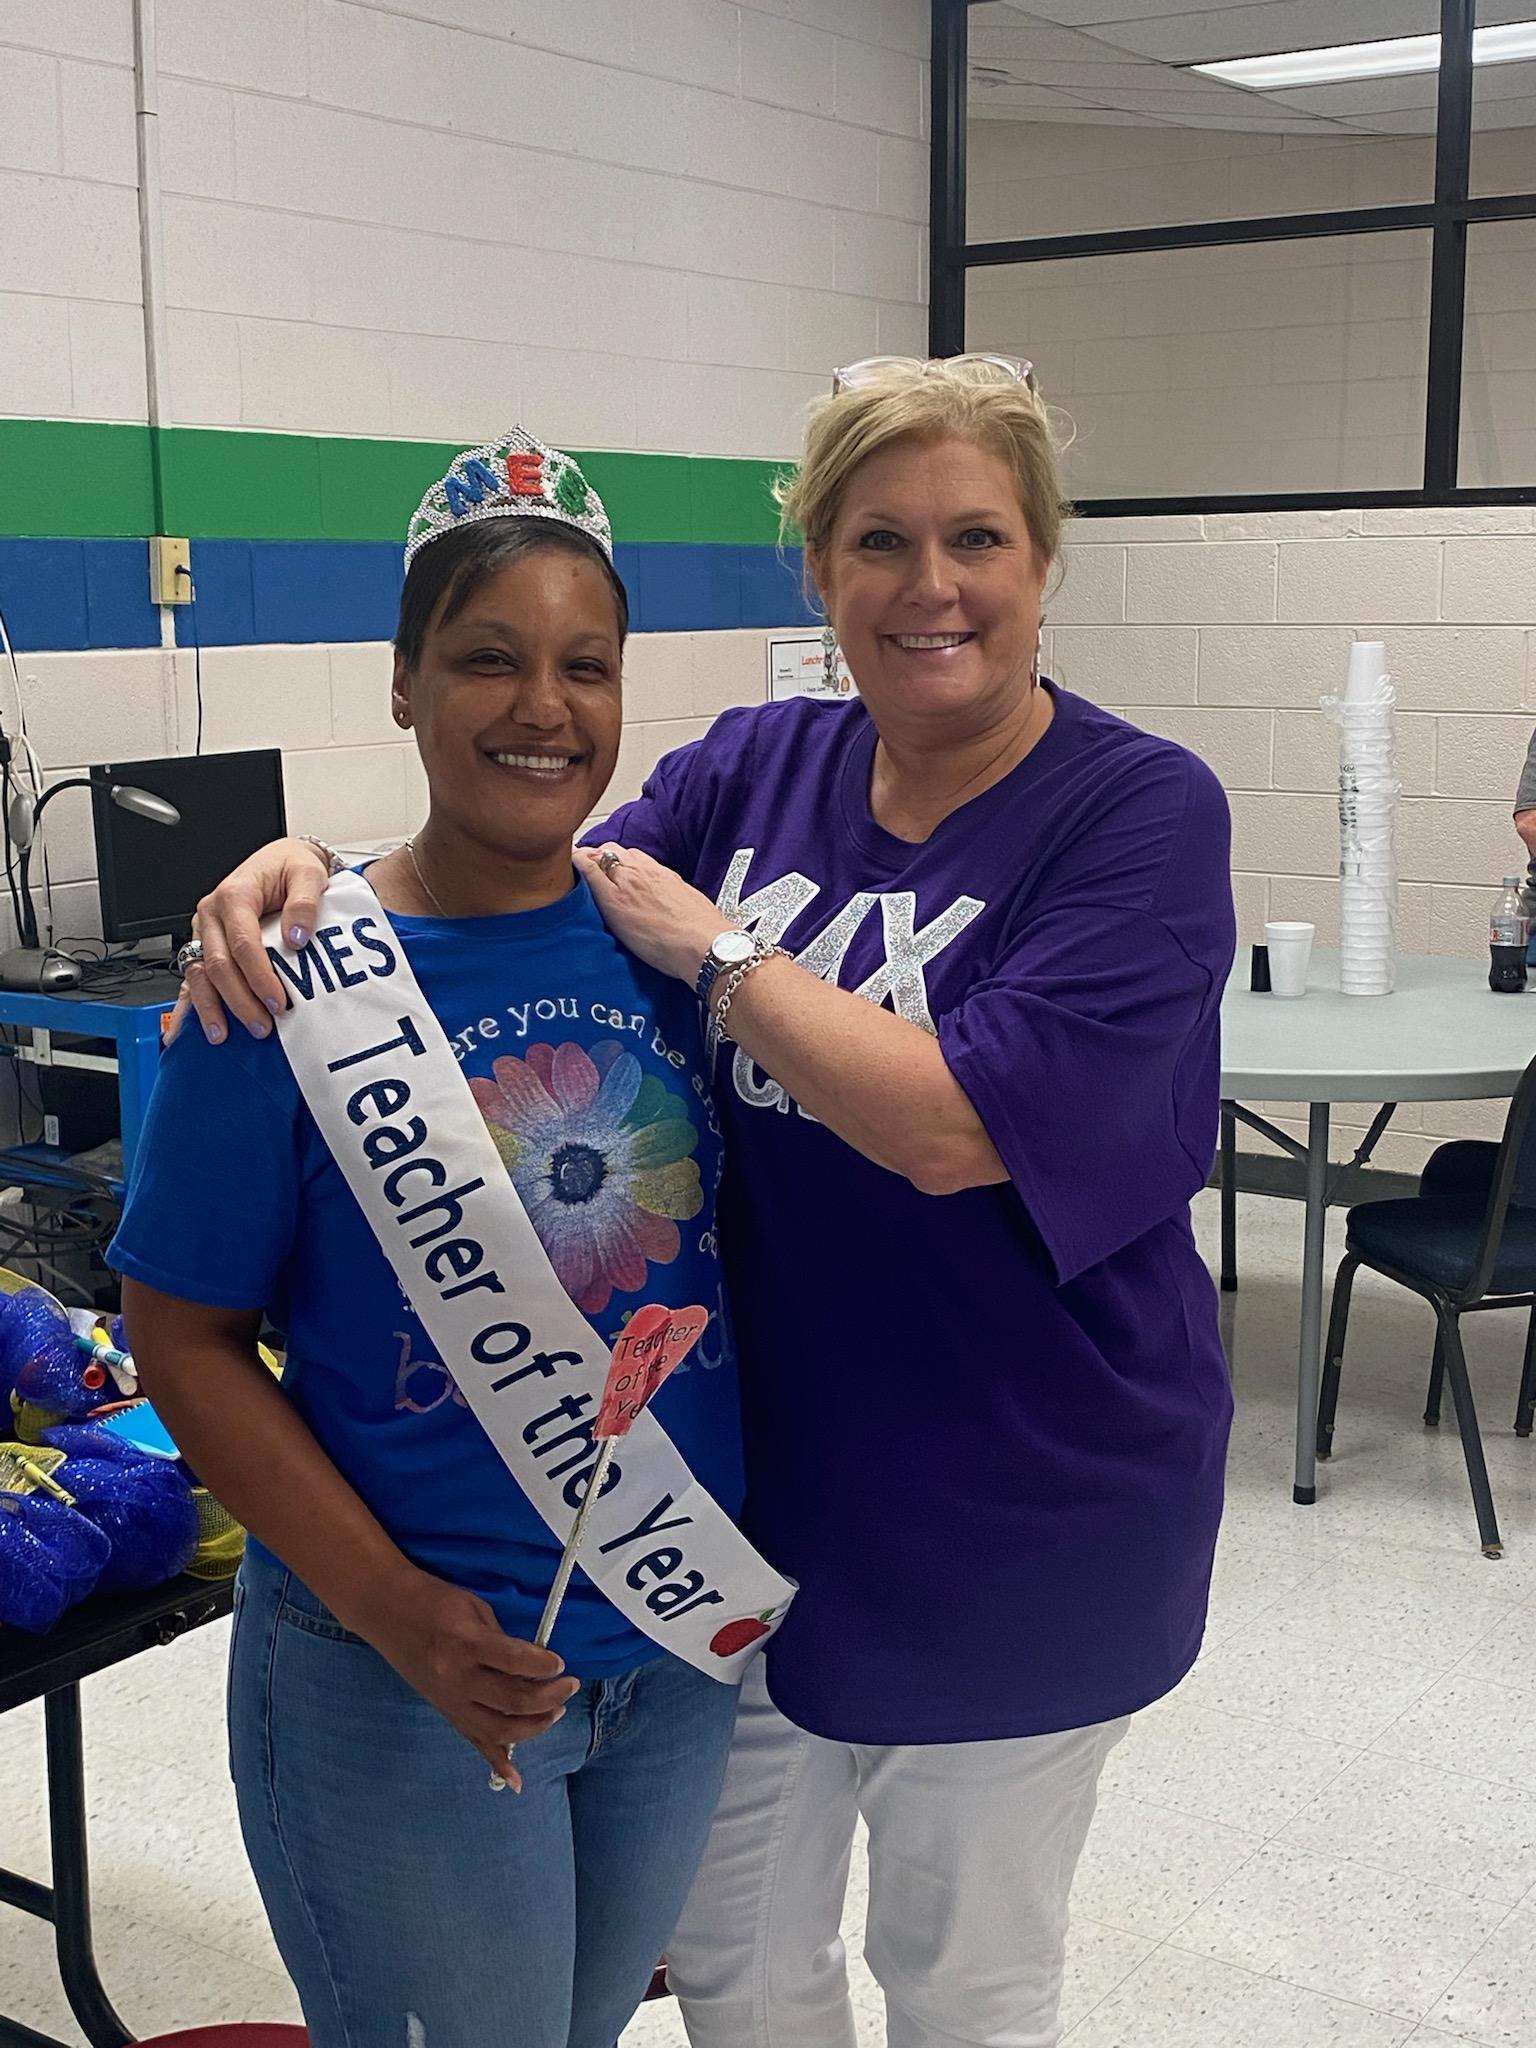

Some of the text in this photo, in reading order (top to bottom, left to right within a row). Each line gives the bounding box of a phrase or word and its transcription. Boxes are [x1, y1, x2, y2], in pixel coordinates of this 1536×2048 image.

[265, 917, 397, 1011] MES
[450, 997, 687, 1069] ere you can be
[327, 1015, 725, 1622] Teacher of the Year
[621, 1321, 698, 1361] Teacher
[615, 1363, 645, 1391] of
